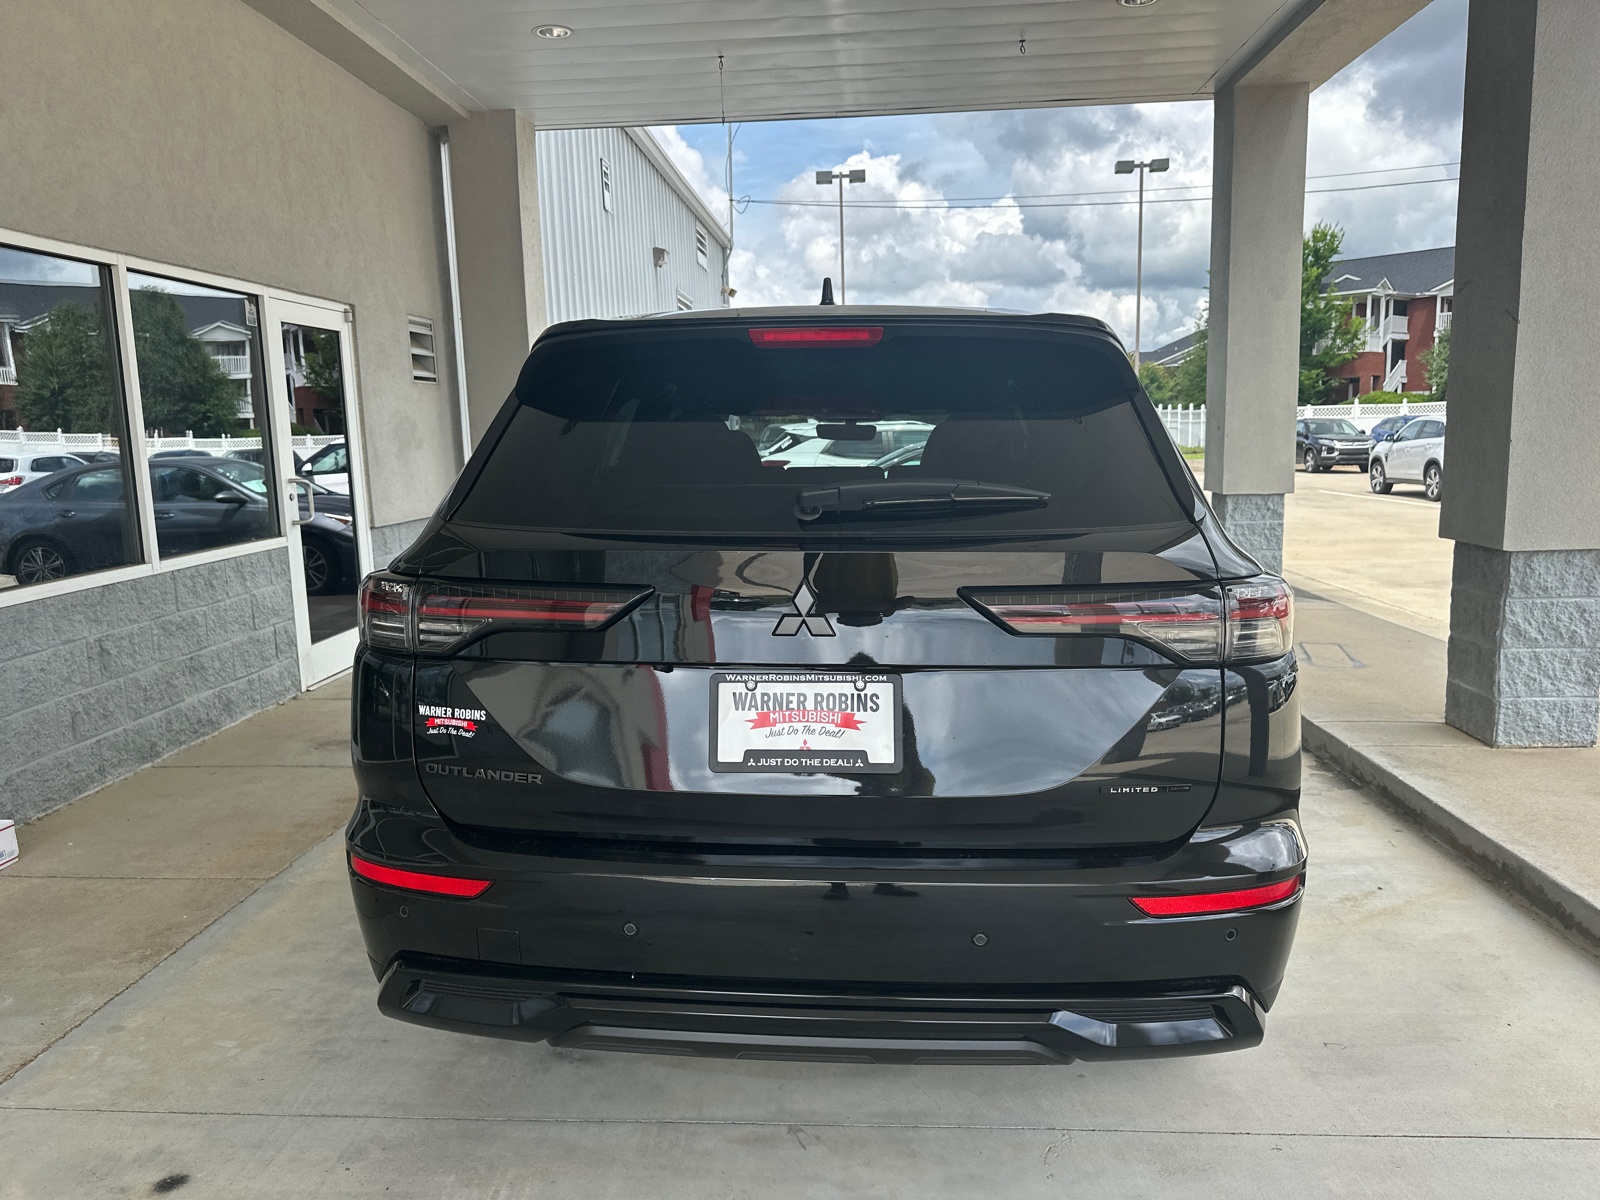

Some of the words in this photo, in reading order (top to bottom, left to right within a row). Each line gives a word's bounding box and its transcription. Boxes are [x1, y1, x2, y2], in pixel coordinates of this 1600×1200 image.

[732, 692, 807, 712] WARNER
[814, 692, 880, 713] ROBINS
[418, 704, 453, 718] WARNER
[454, 708, 486, 721] ROBINS
[769, 711, 841, 724] MITSUBISHI
[434, 719, 468, 727] MITSUBISHI
[765, 726, 785, 738] Just
[787, 725, 799, 736] Do
[801, 725, 817, 735] The
[818, 726, 846, 739] Deal!
[757, 758, 782, 766] JUST
[784, 758, 799, 766] DO
[801, 758, 821, 766] THE
[823, 759, 853, 767] DEAL!
[425, 763, 543, 785] OUTLANDER
